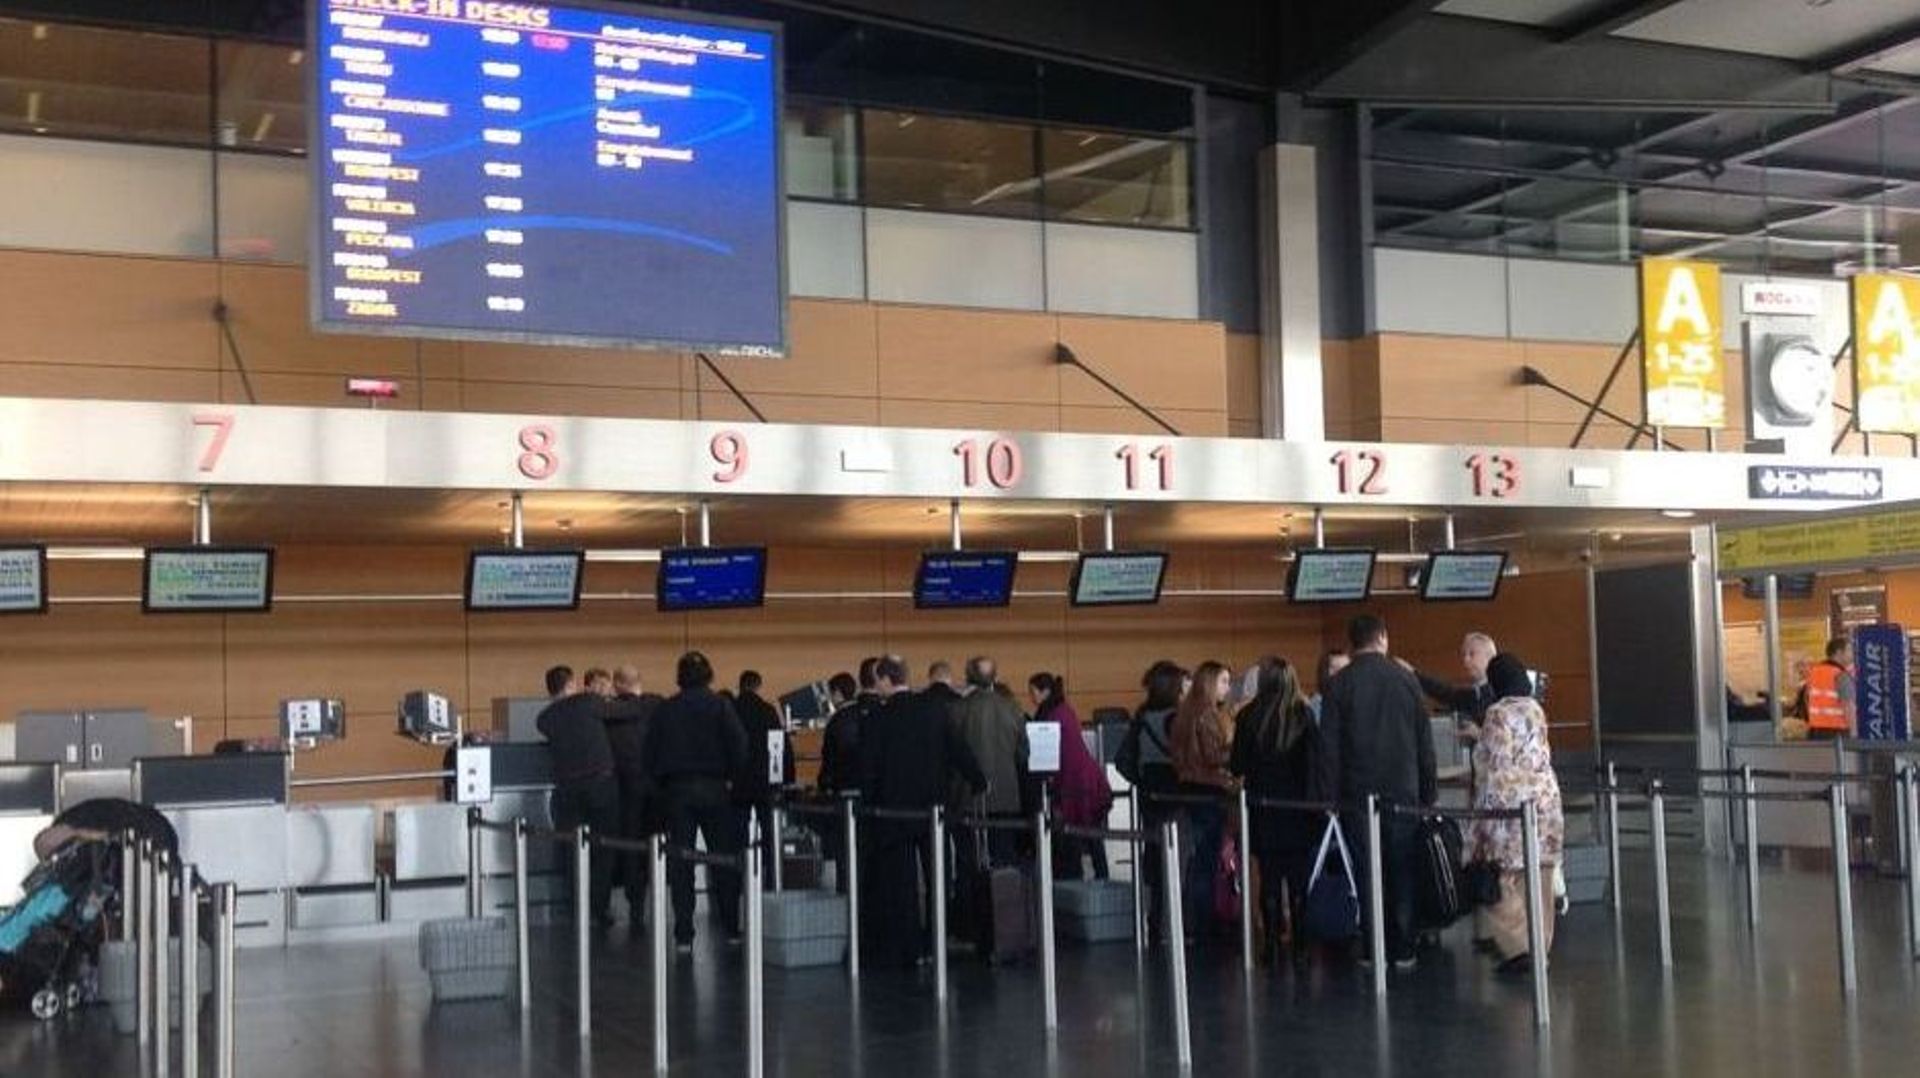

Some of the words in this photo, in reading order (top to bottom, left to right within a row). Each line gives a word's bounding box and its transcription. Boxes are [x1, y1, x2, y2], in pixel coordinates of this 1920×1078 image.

[465, 1, 550, 27] DESKS
[1656, 266, 1712, 334] A
[192, 414, 235, 472] 7
[517, 425, 559, 479] 8
[710, 429, 748, 483] 9
[954, 437, 1023, 489] 10
[1115, 443, 1175, 490] 11
[1330, 449, 1388, 495] 12
[1465, 453, 1521, 497] 13
[1864, 642, 1882, 741] ANAIR
